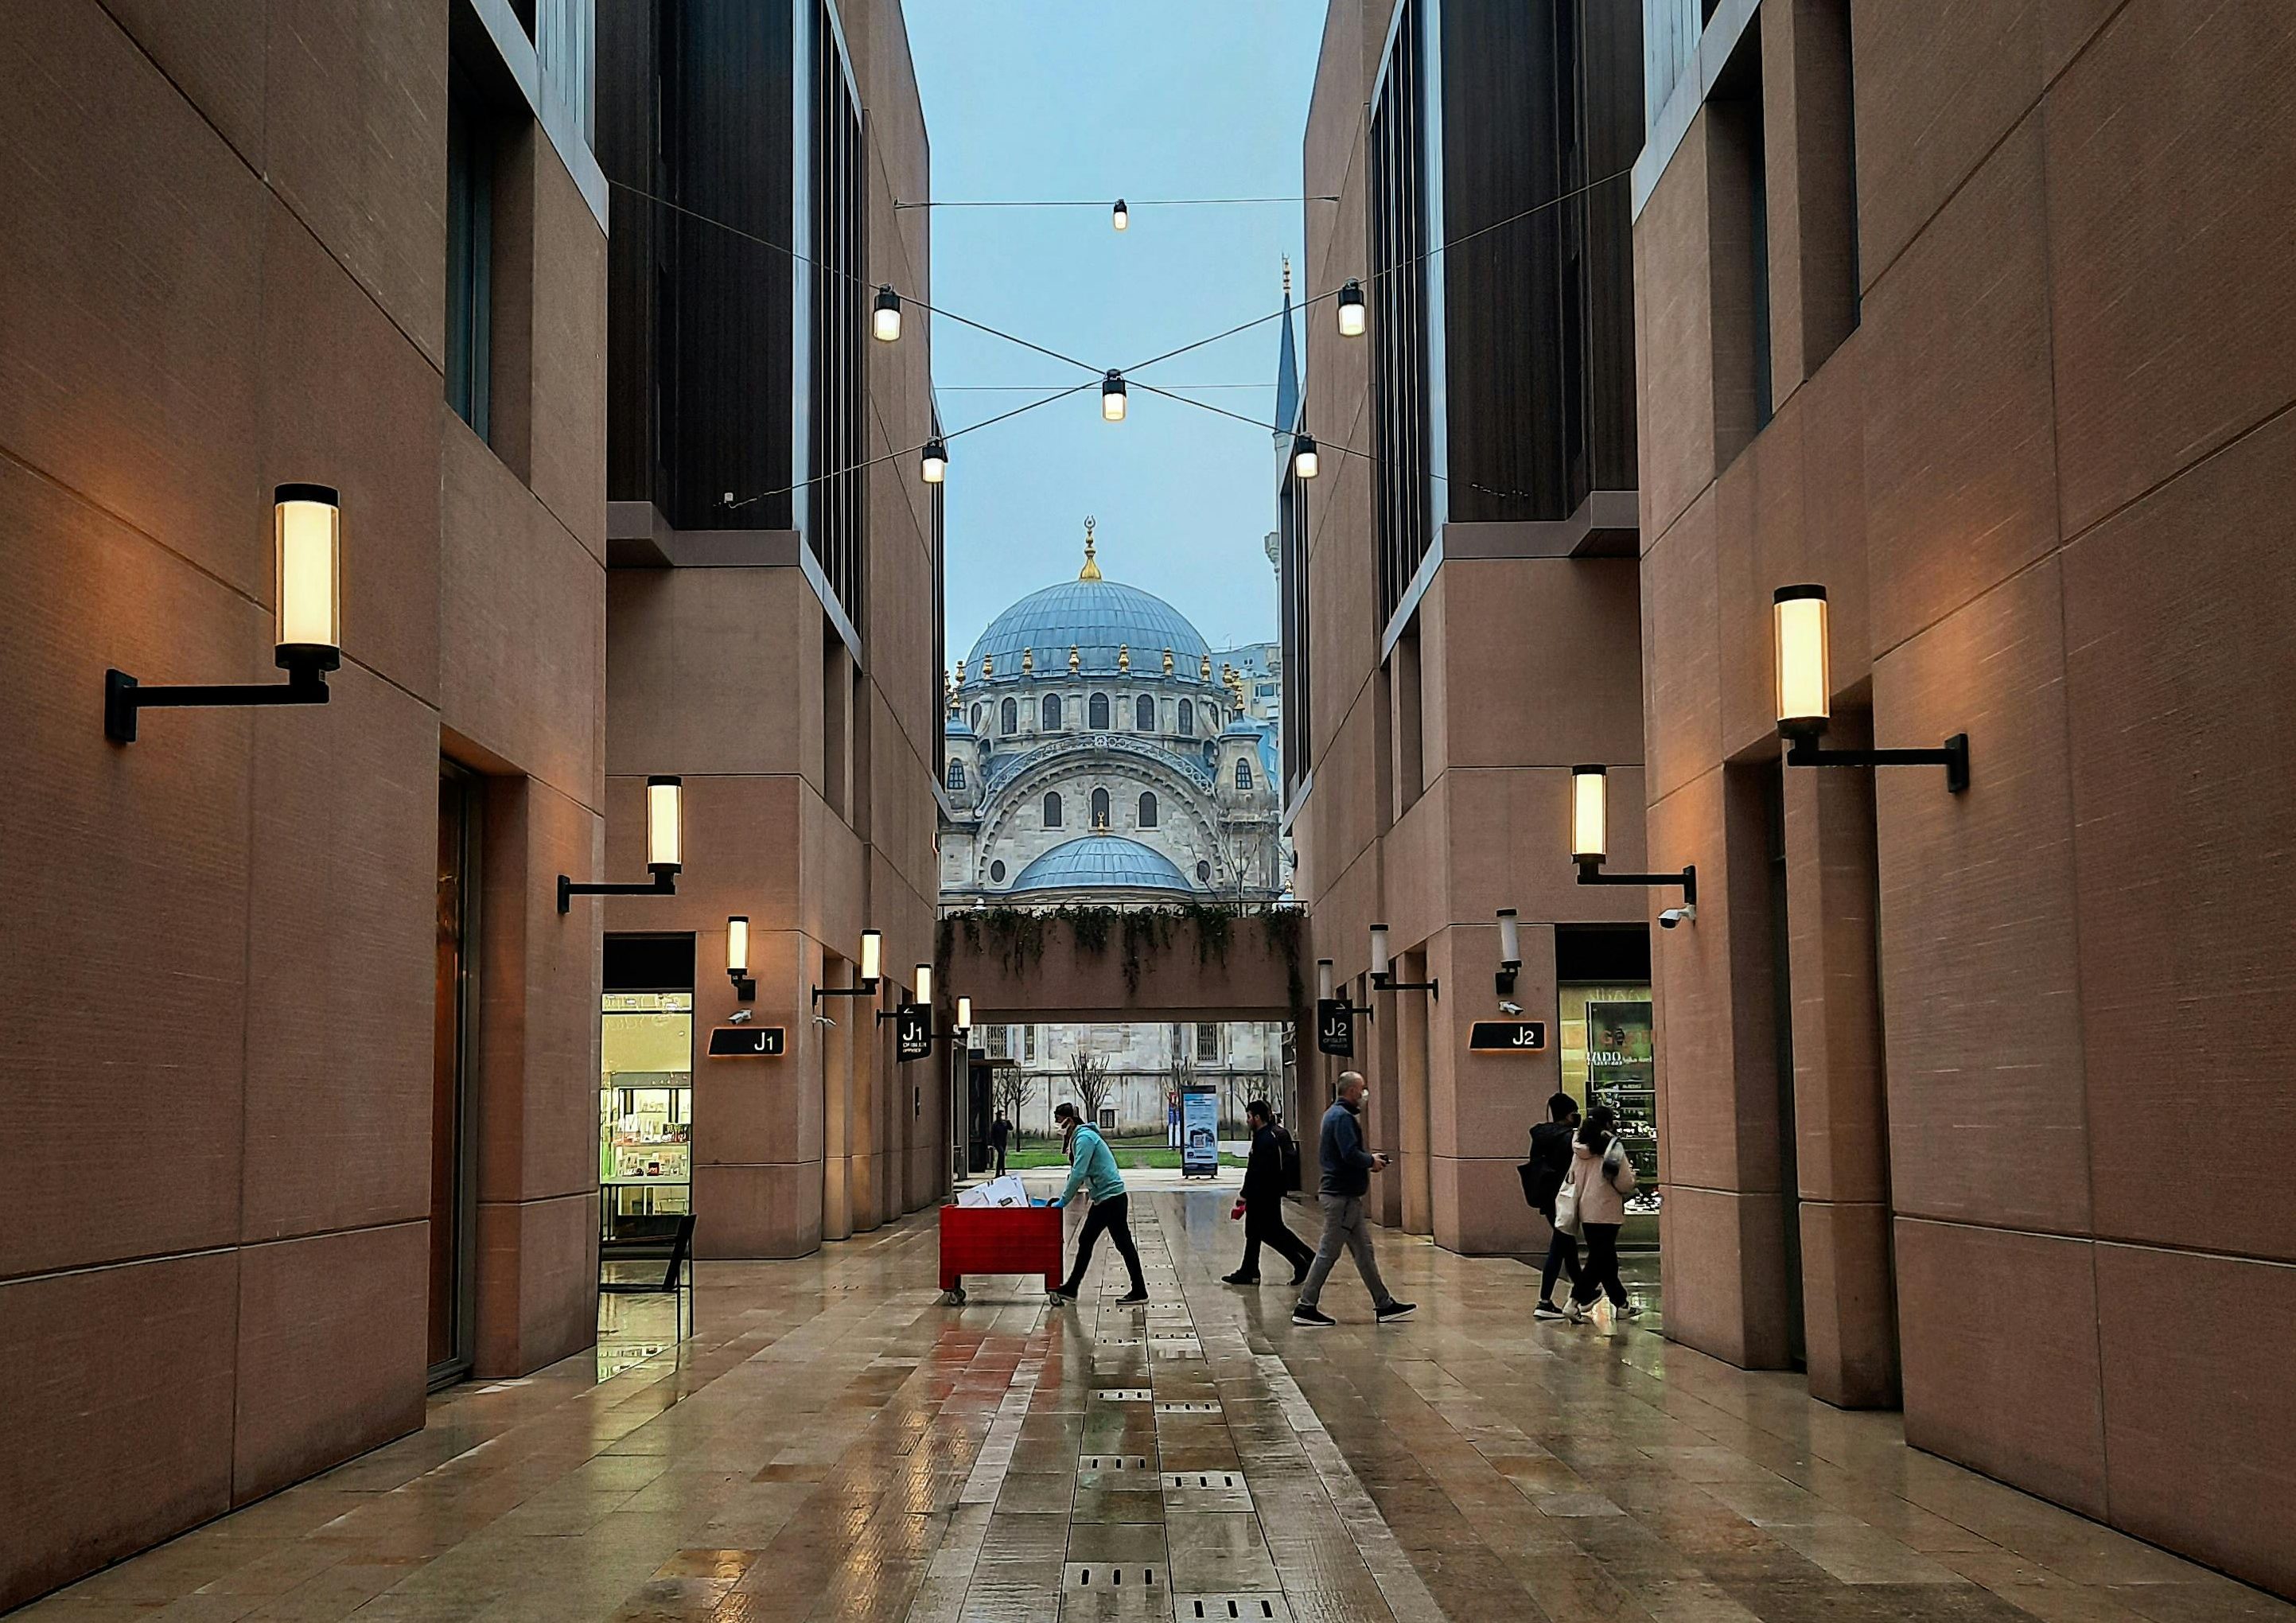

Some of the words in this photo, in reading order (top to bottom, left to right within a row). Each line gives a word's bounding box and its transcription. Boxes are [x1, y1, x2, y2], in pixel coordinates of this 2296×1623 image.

[902, 1022, 922, 1041] J1
[1324, 1018, 1347, 1036] J2
[1512, 1026, 1535, 1045] J2
[754, 1032, 773, 1051] J1
